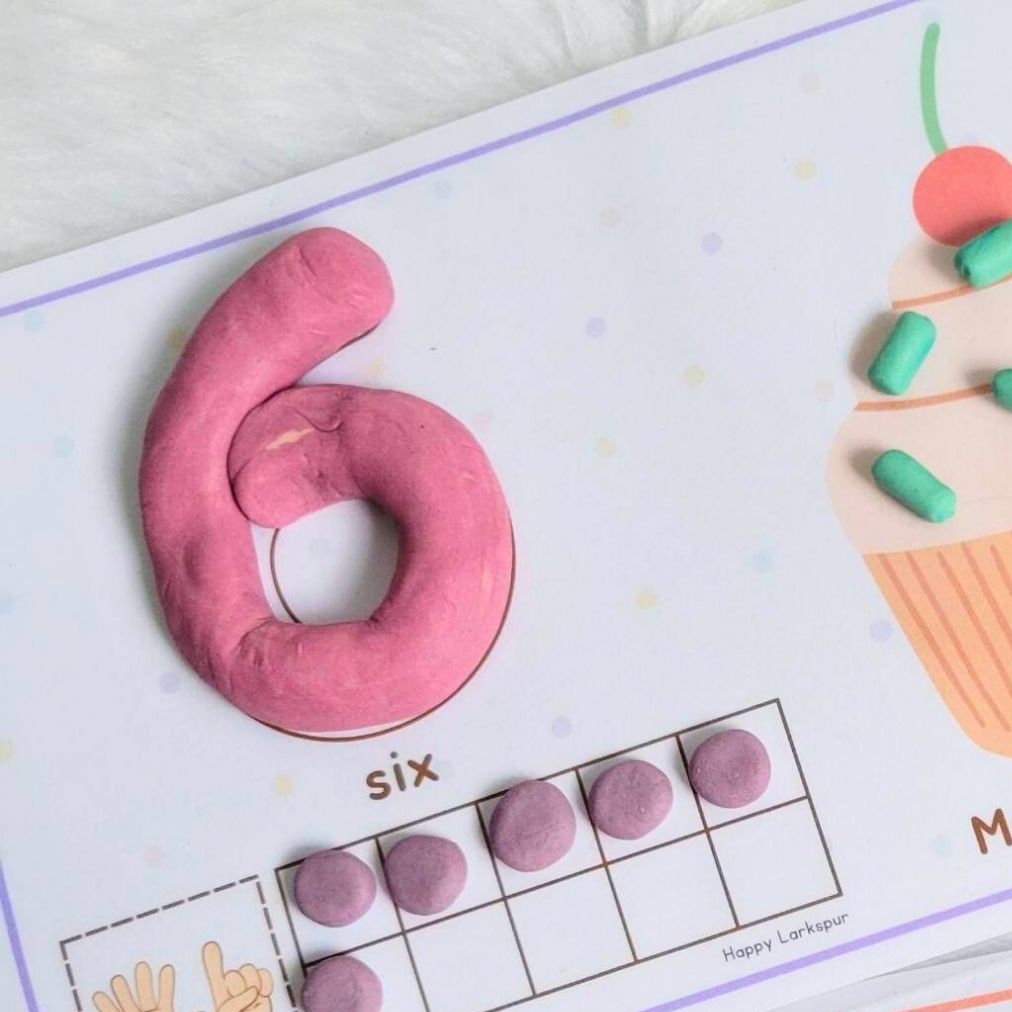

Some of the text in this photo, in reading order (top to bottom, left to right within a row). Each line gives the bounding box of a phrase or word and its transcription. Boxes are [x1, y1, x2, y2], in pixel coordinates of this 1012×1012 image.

[138, 226, 515, 742] 6
[366, 752, 439, 800] six
[722, 913, 849, 962] Happy Larkspur
